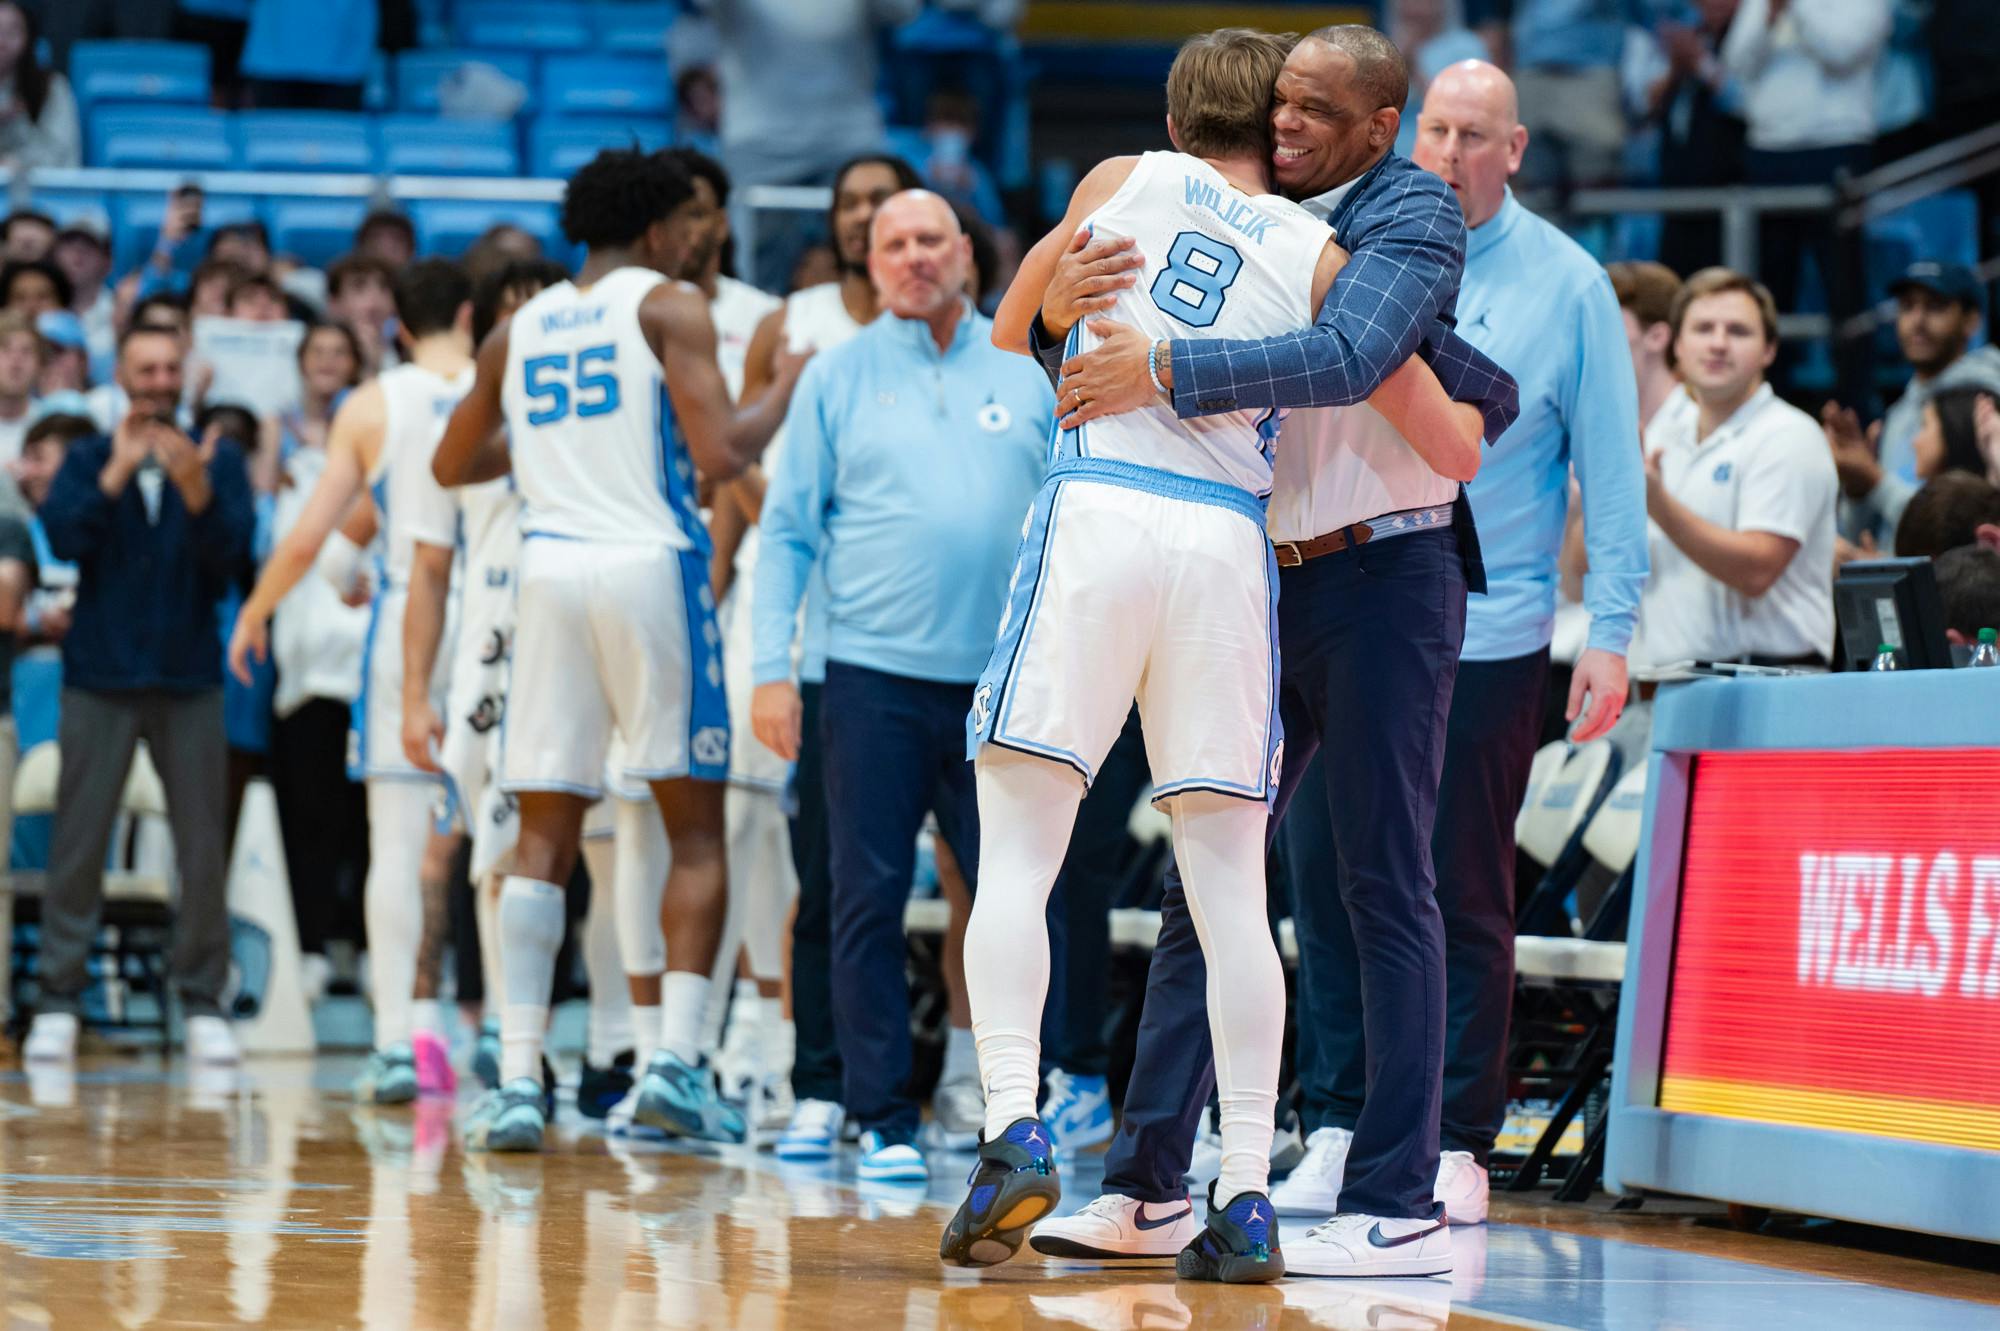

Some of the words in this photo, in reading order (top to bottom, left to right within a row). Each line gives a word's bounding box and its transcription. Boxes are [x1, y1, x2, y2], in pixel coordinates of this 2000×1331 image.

[1184, 174, 1281, 246] WOJCIK
[1150, 231, 1244, 328] 8
[524, 343, 621, 426] 55
[1796, 850, 1958, 997] WELLS
